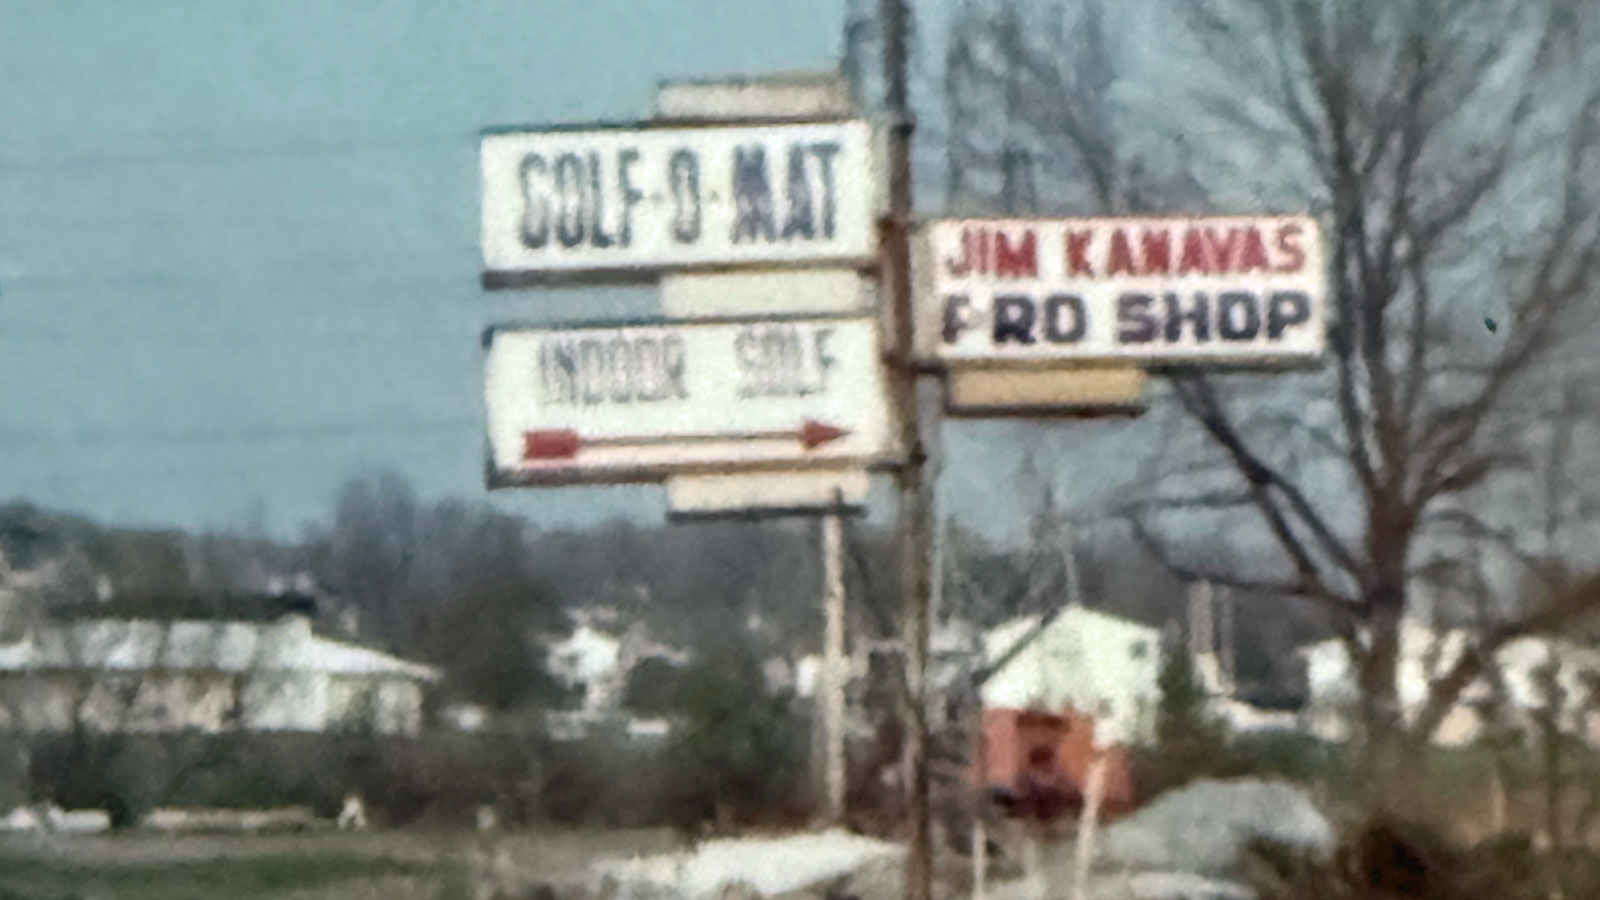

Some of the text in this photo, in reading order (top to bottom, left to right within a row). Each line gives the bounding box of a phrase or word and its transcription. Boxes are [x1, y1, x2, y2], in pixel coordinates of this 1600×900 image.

[947, 227, 1038, 277] JIM
[941, 290, 1311, 344] PRO SHOP
